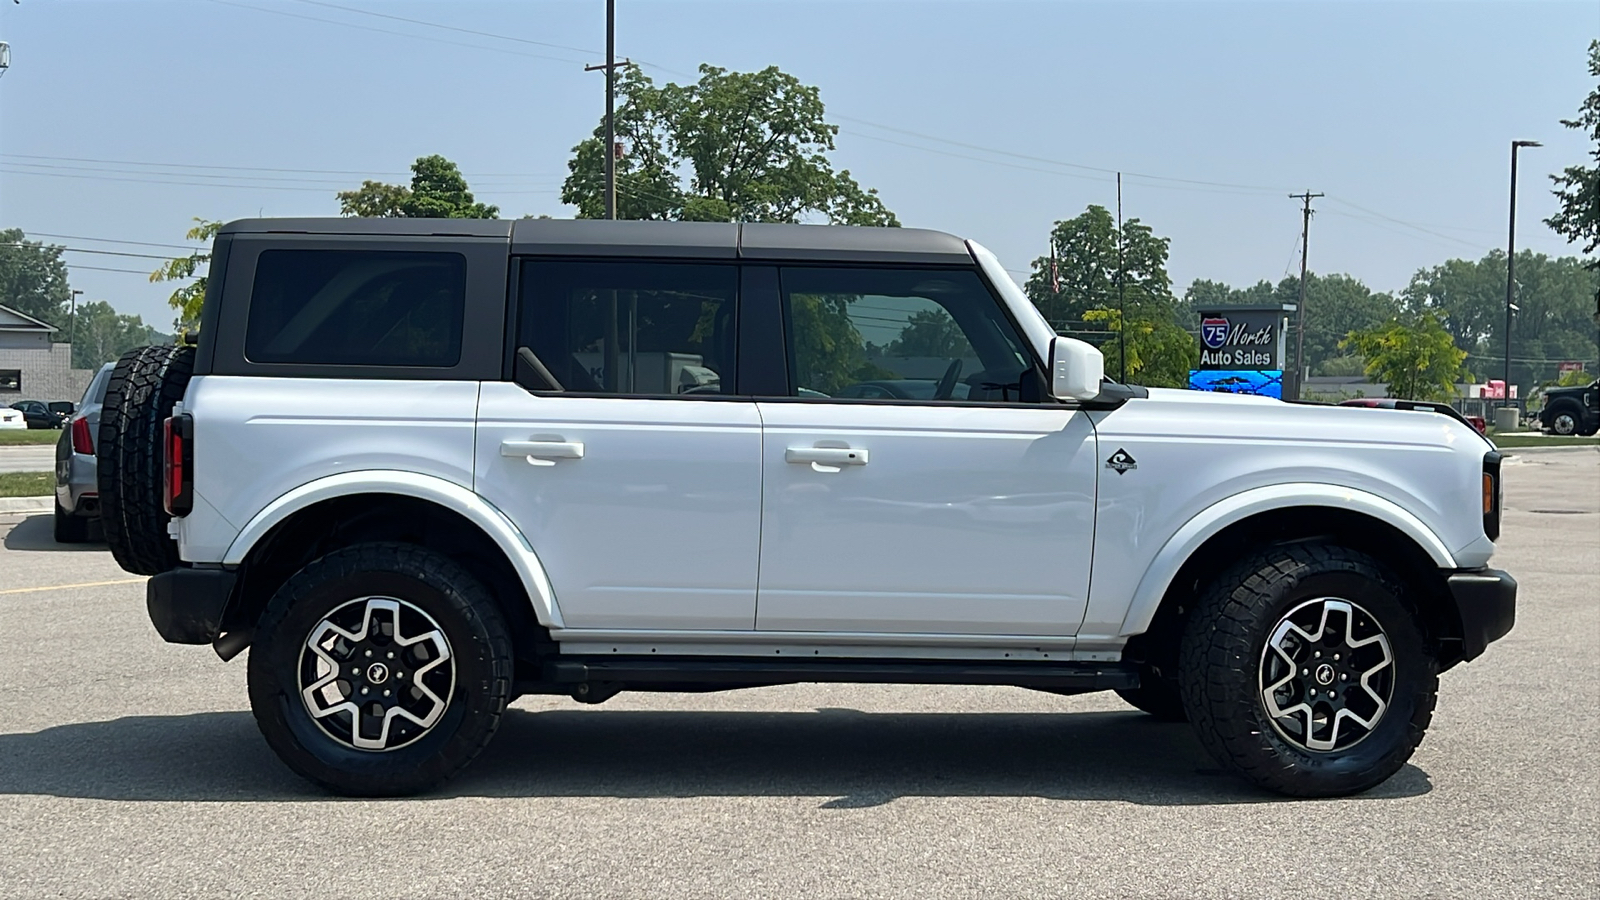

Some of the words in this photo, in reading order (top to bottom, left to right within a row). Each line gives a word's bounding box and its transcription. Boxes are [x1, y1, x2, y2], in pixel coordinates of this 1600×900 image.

[1206, 327, 1225, 341] 75
[1226, 323, 1272, 346] North
[1200, 349, 1232, 365] Auto
[1234, 350, 1271, 365] Sales
